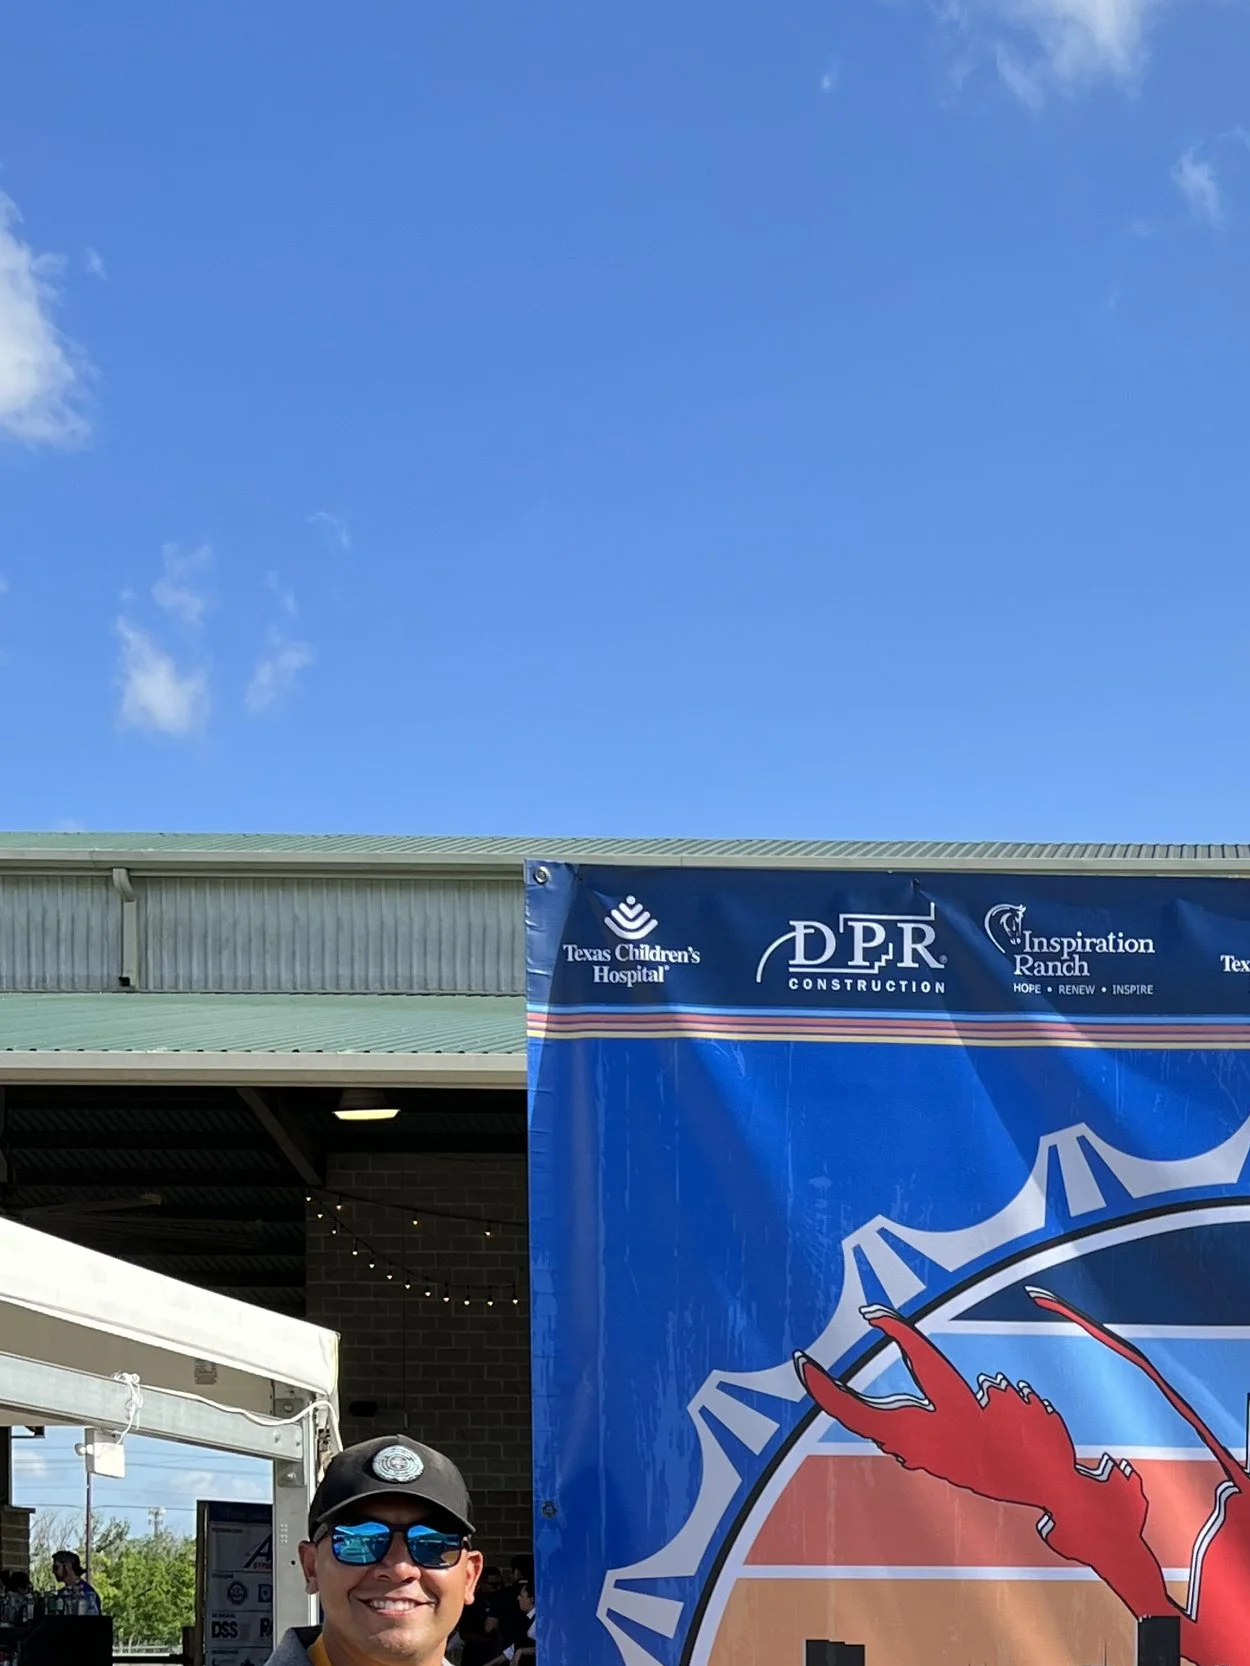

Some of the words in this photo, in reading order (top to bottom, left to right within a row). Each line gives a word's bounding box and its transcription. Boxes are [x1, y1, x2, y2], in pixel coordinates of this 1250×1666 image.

[562, 943, 612, 962] Texas
[614, 943, 701, 964] Children's
[788, 920, 945, 969] DPR
[1022, 930, 1156, 960] Inspiration
[593, 965, 667, 987] Hospital
[1013, 954, 1091, 977] Ranch
[788, 977, 946, 994] CONSTRUCTION
[1013, 982, 1042, 994] HOPE
[1058, 984, 1096, 995] RENEW
[1112, 984, 1154, 995] INSPIRE
[211, 1621, 238, 1638] DSS
